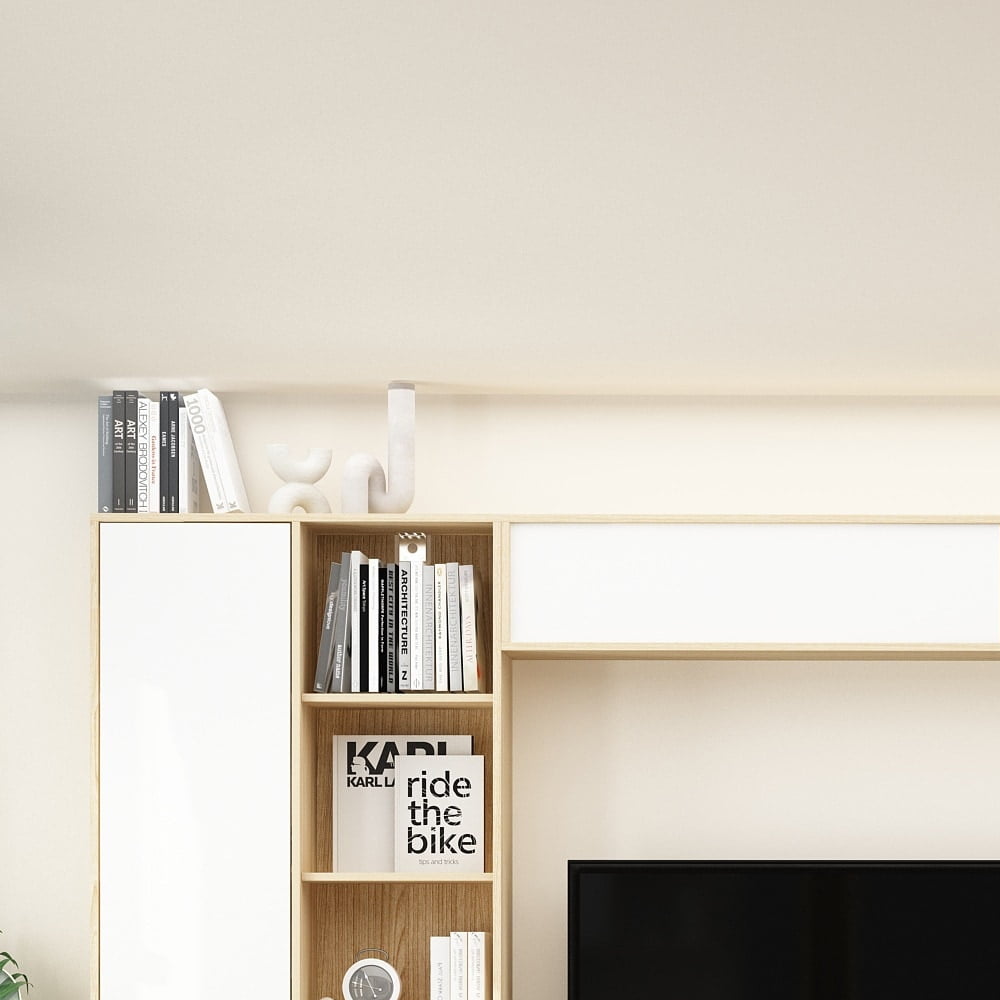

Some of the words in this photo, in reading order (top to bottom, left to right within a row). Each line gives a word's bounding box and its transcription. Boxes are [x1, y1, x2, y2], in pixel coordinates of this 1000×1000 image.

[114, 419, 124, 439] ART
[126, 419, 136, 439] ART
[138, 401, 148, 440] ALEXEY
[186, 398, 206, 435] 1000
[138, 443, 148, 508] BRODOVITCH
[347, 777, 382, 787] KARL
[407, 770, 472, 798] ride
[407, 799, 462, 826] the
[407, 827, 477, 854] bike
